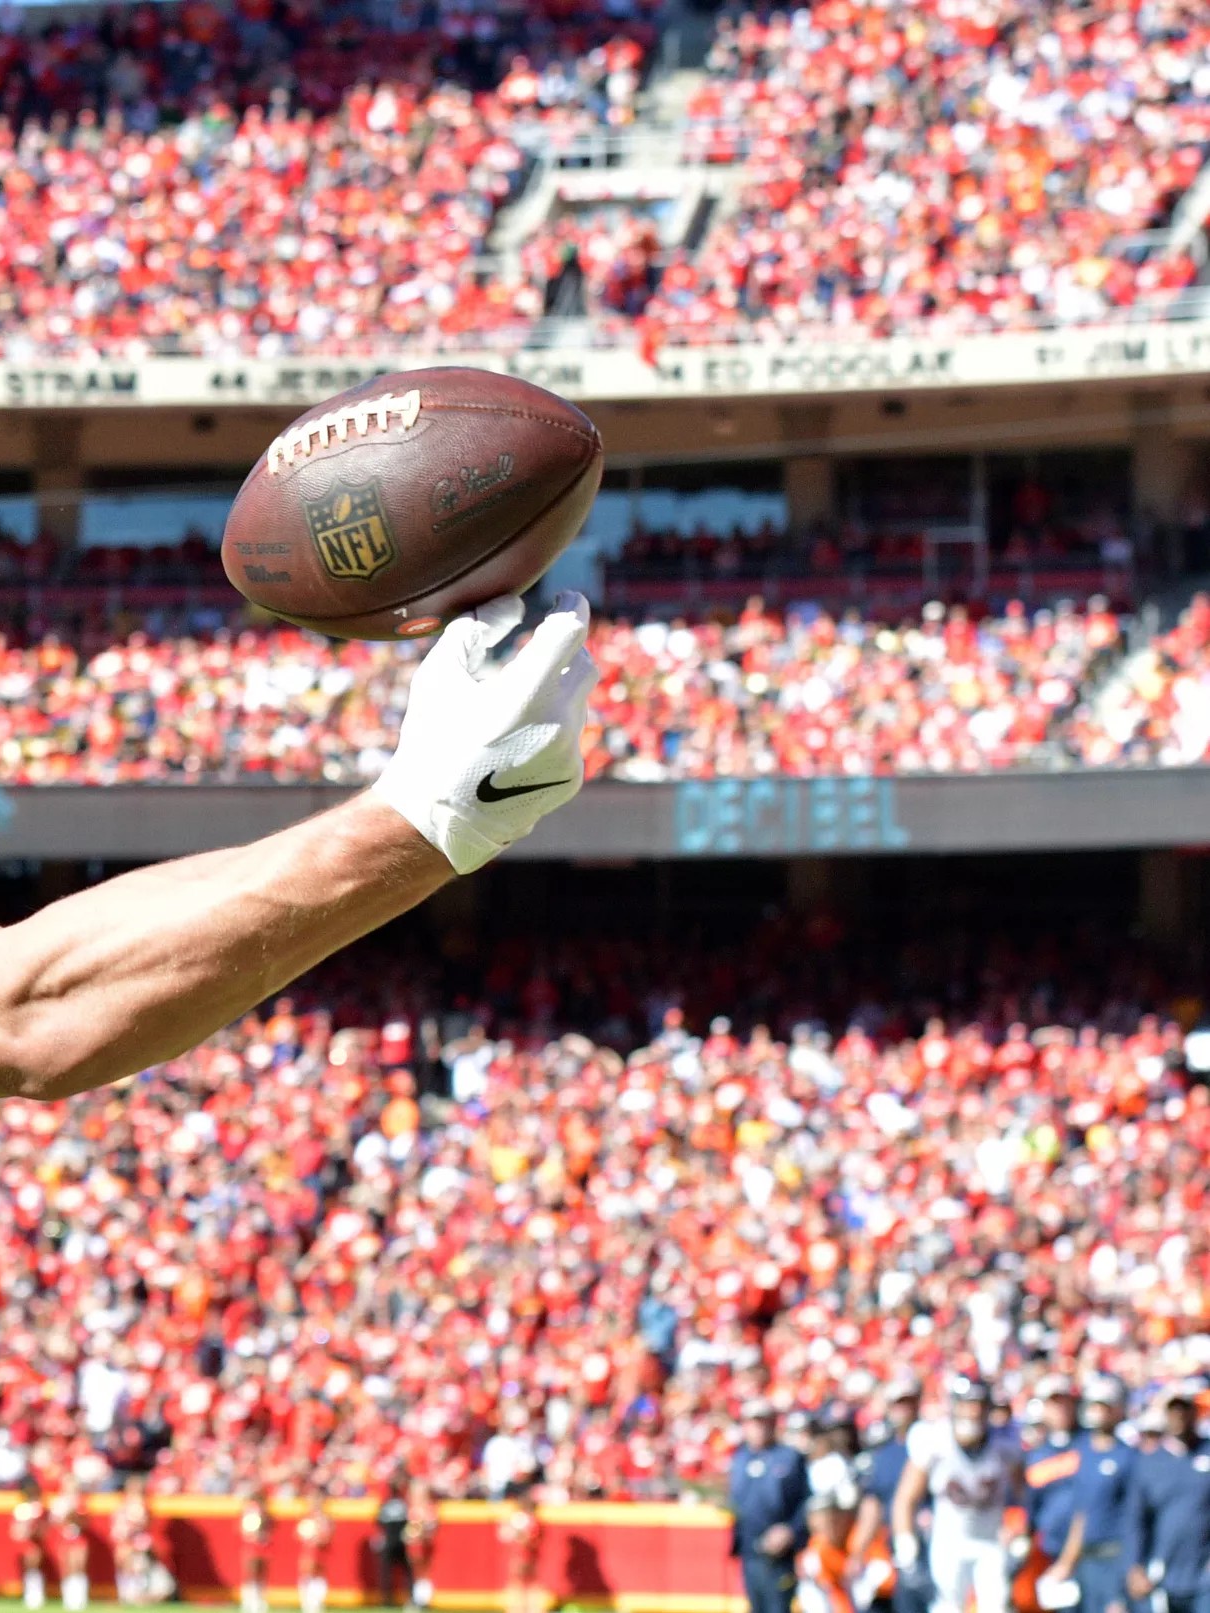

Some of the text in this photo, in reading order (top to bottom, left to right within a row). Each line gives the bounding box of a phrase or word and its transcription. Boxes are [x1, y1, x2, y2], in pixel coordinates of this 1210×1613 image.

[5, 370, 139, 395] STRAM
[703, 358, 752, 380] ED
[769, 350, 954, 378] PODOLAK
[321, 518, 388, 573] NFL
[675, 776, 909, 854] DECIBEL
